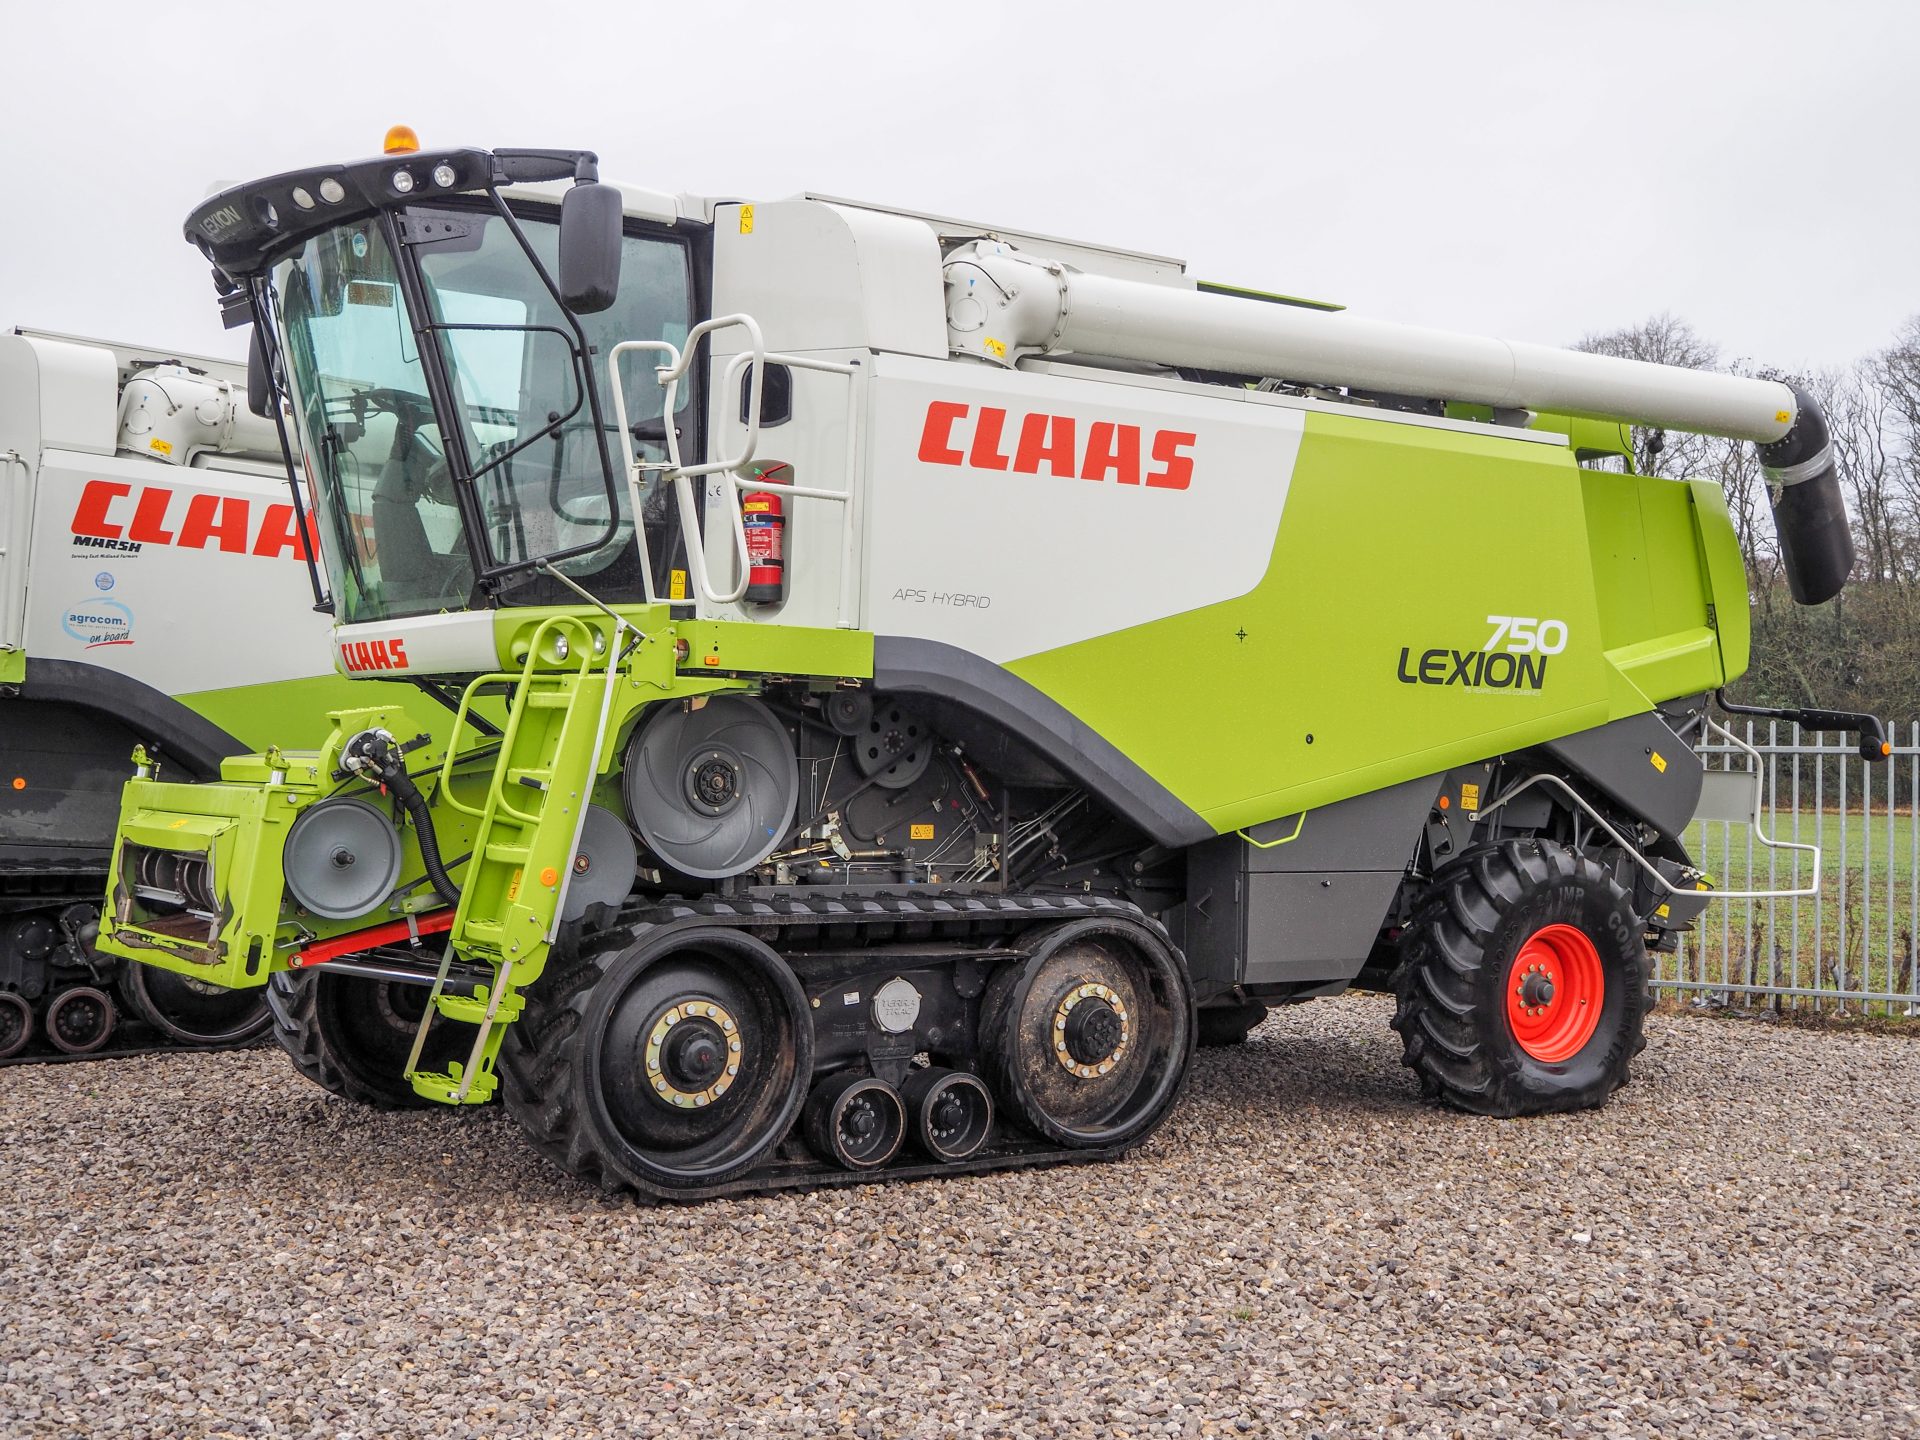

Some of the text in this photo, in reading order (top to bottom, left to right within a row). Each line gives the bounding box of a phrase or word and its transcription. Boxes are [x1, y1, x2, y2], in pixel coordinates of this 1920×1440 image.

[199, 205, 242, 236] LEXION
[917, 400, 1197, 491] CLAAS
[73, 535, 142, 553] MARSH
[892, 588, 991, 609] APS HYBRID
[90, 629, 130, 644] on board
[1483, 615, 1568, 655] 750
[341, 638, 409, 672] CLAAS
[1397, 647, 1548, 690] LEXION
